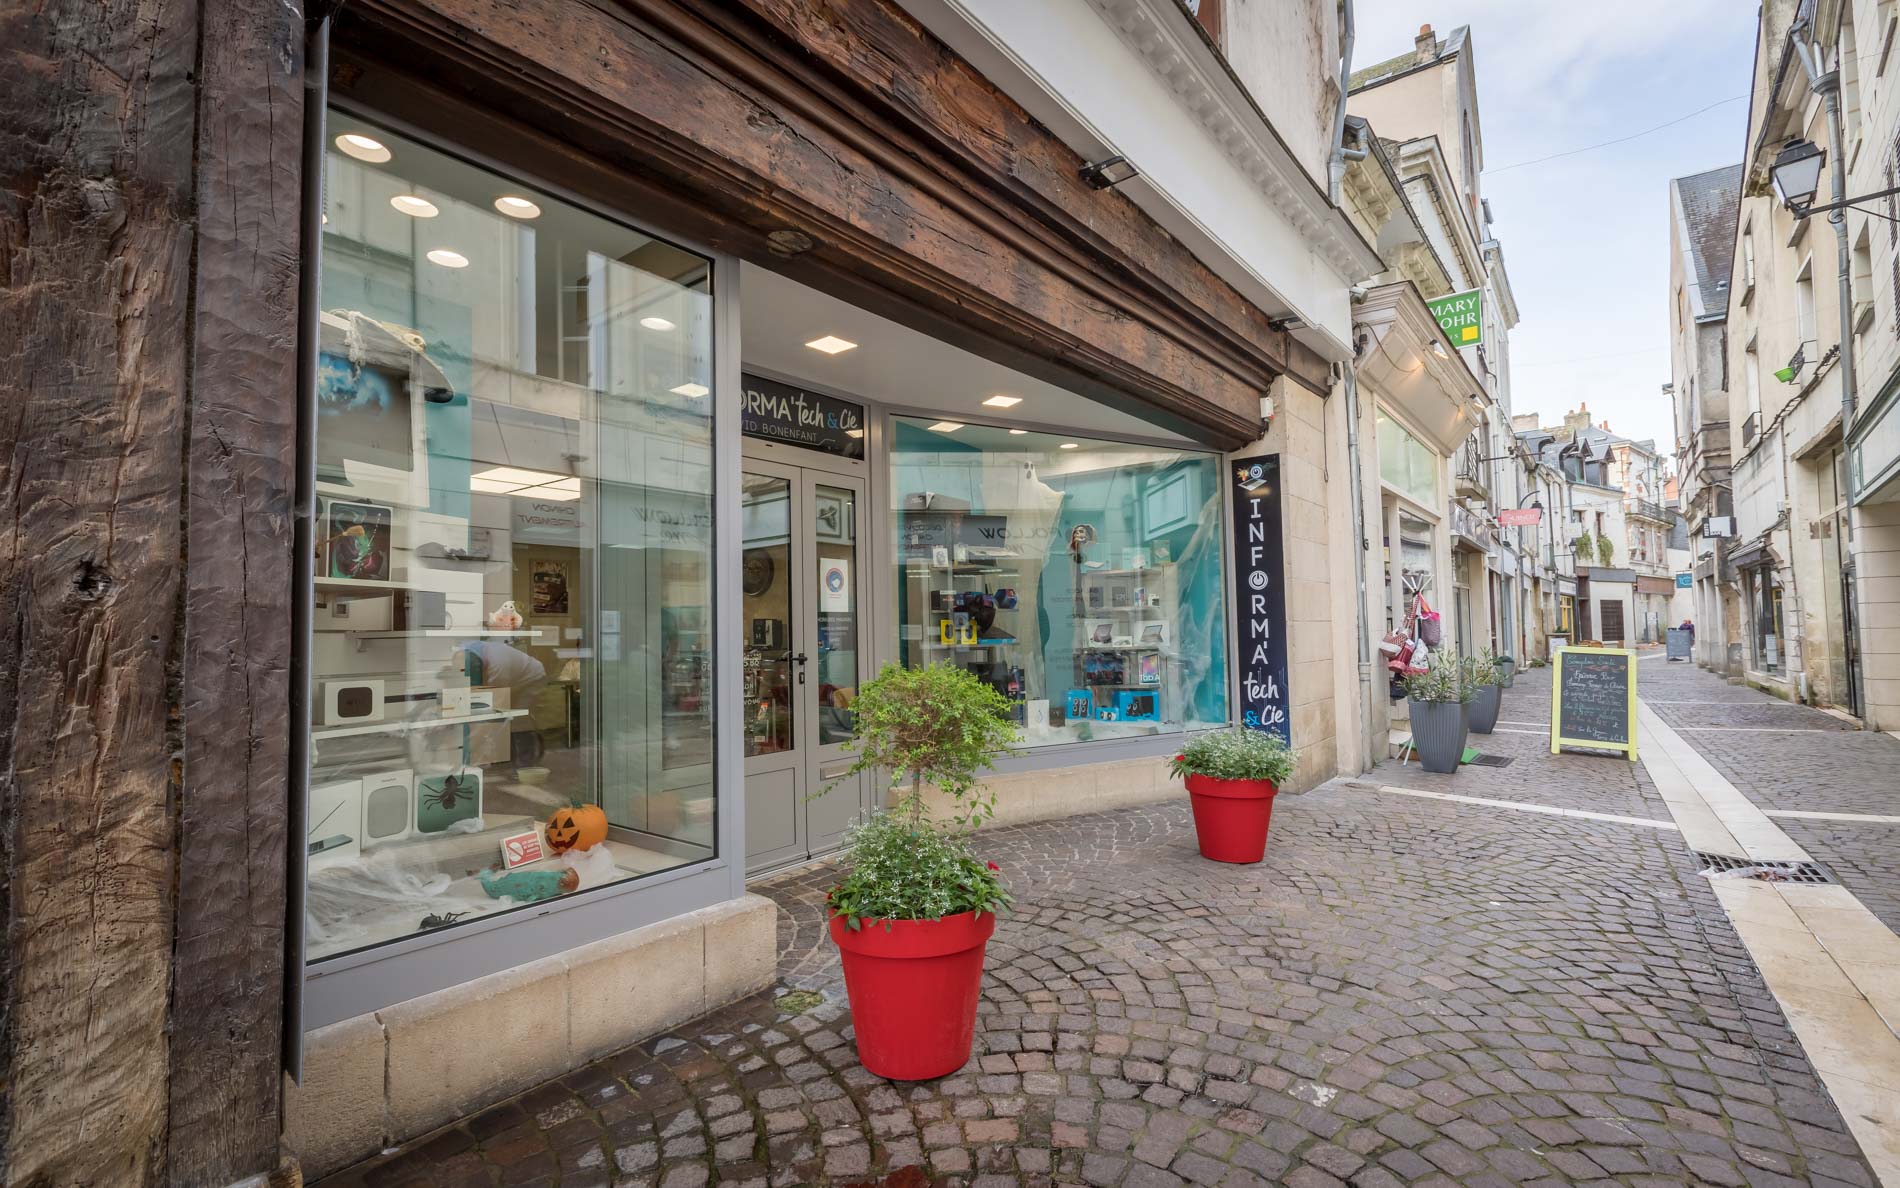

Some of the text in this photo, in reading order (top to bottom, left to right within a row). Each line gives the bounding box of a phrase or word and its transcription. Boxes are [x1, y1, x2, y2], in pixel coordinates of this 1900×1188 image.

[1429, 297, 1476, 316] MARY
[1440, 312, 1477, 329] OHR
[762, 424, 817, 442] BONENFANT
[1243, 672, 1279, 703] tech
[1261, 704, 1285, 726] Cie
